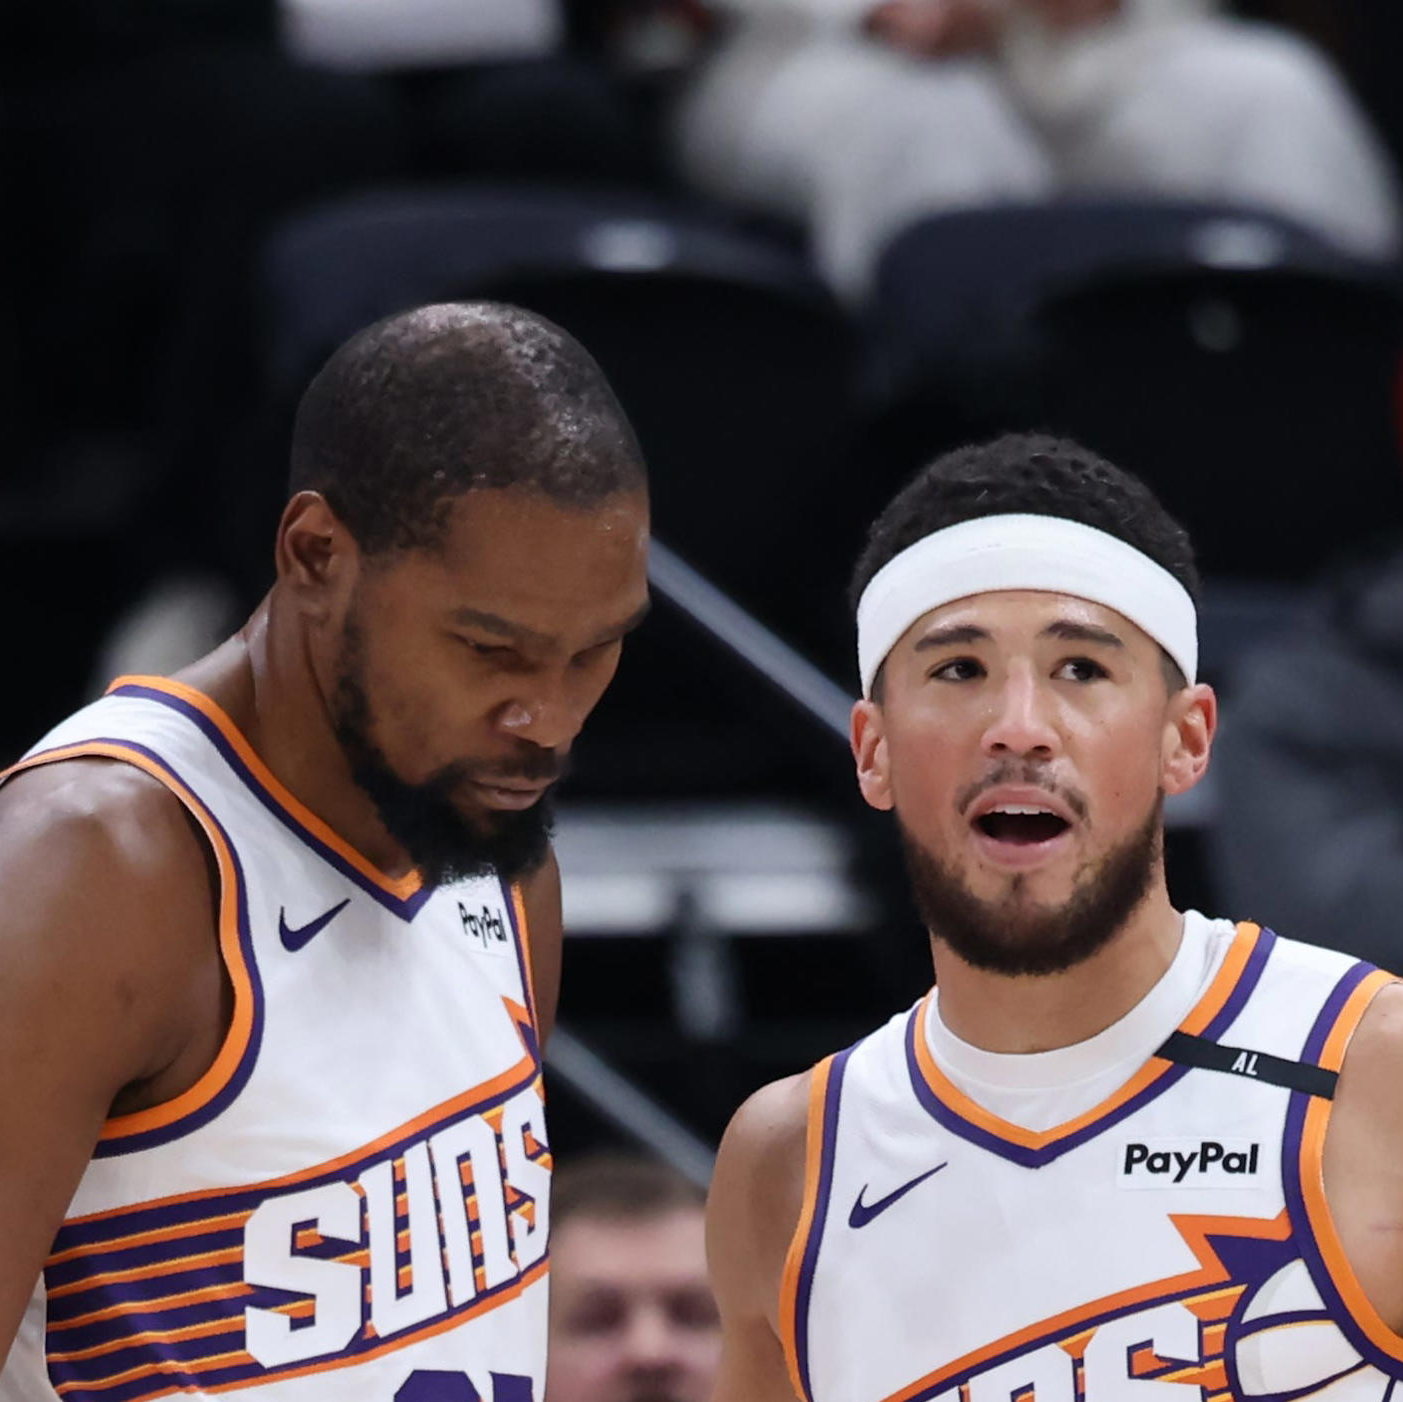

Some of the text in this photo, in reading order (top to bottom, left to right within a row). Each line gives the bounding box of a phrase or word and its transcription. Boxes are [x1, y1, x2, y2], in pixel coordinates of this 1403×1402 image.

[457, 901, 508, 949] PayPal
[1231, 1052, 1259, 1077] AL
[1124, 1141, 1260, 1184] PayPal
[243, 1086, 553, 1370] SUNS
